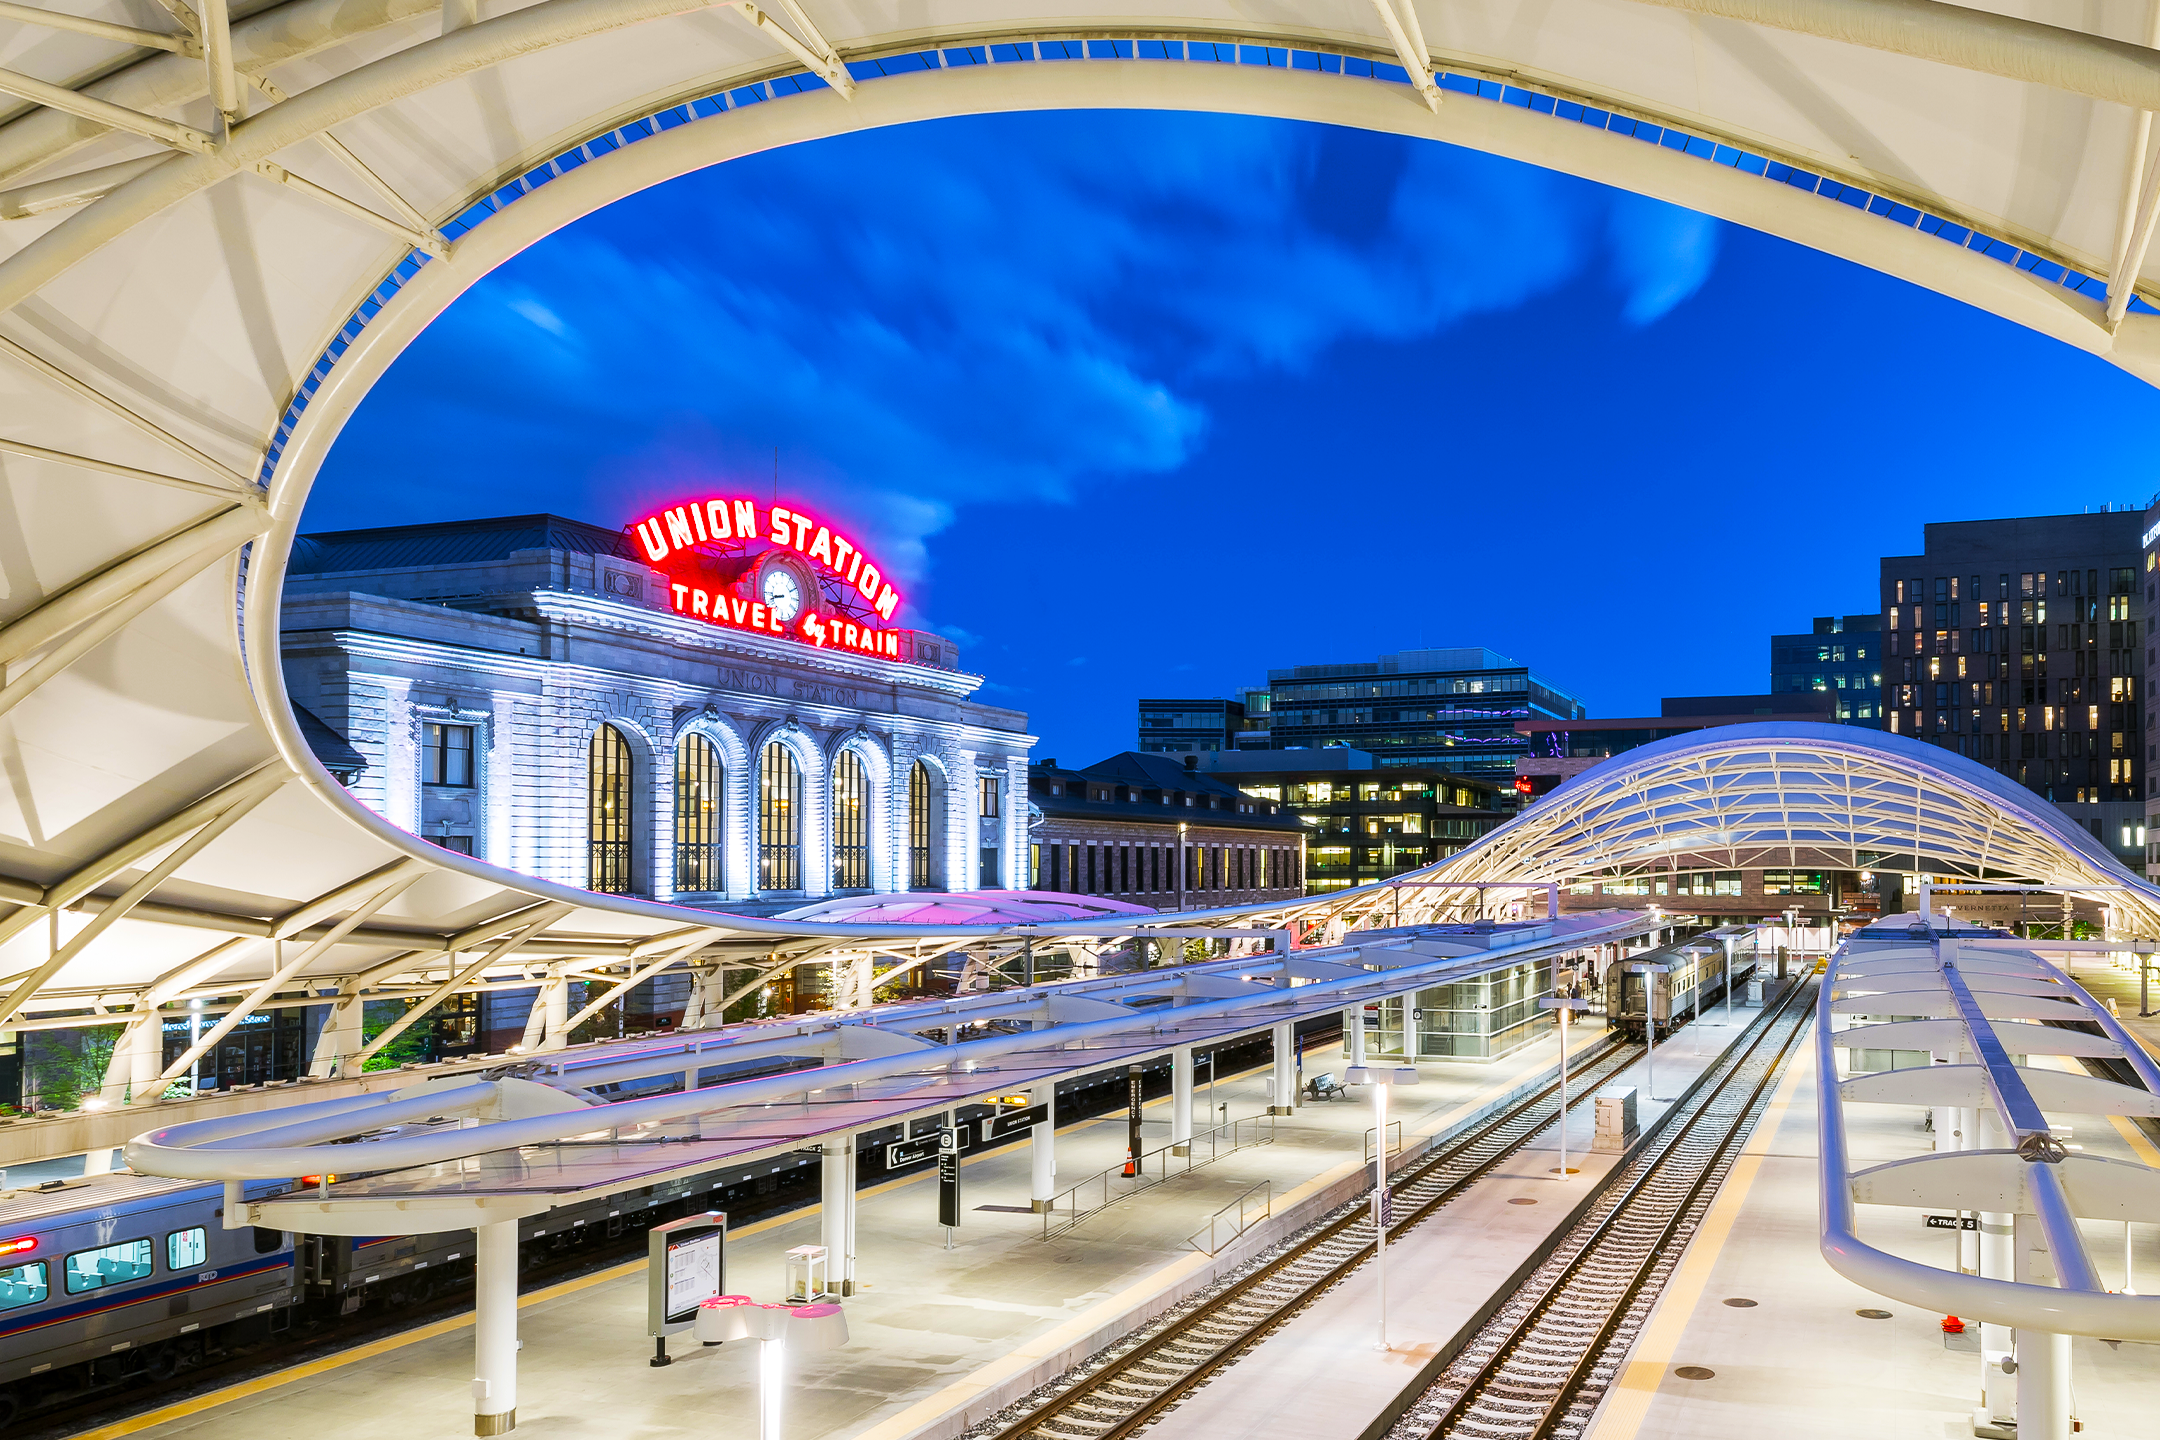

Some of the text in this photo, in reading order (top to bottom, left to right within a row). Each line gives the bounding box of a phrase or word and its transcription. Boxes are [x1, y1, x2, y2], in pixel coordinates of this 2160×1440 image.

[637, 499, 899, 621] UNION STATION
[671, 583, 898, 656] TRAVEL by TRAIN
[717, 667, 858, 706] UNION STATION
[943, 1136, 949, 1145] E
[1966, 1220, 1974, 1228] 5
